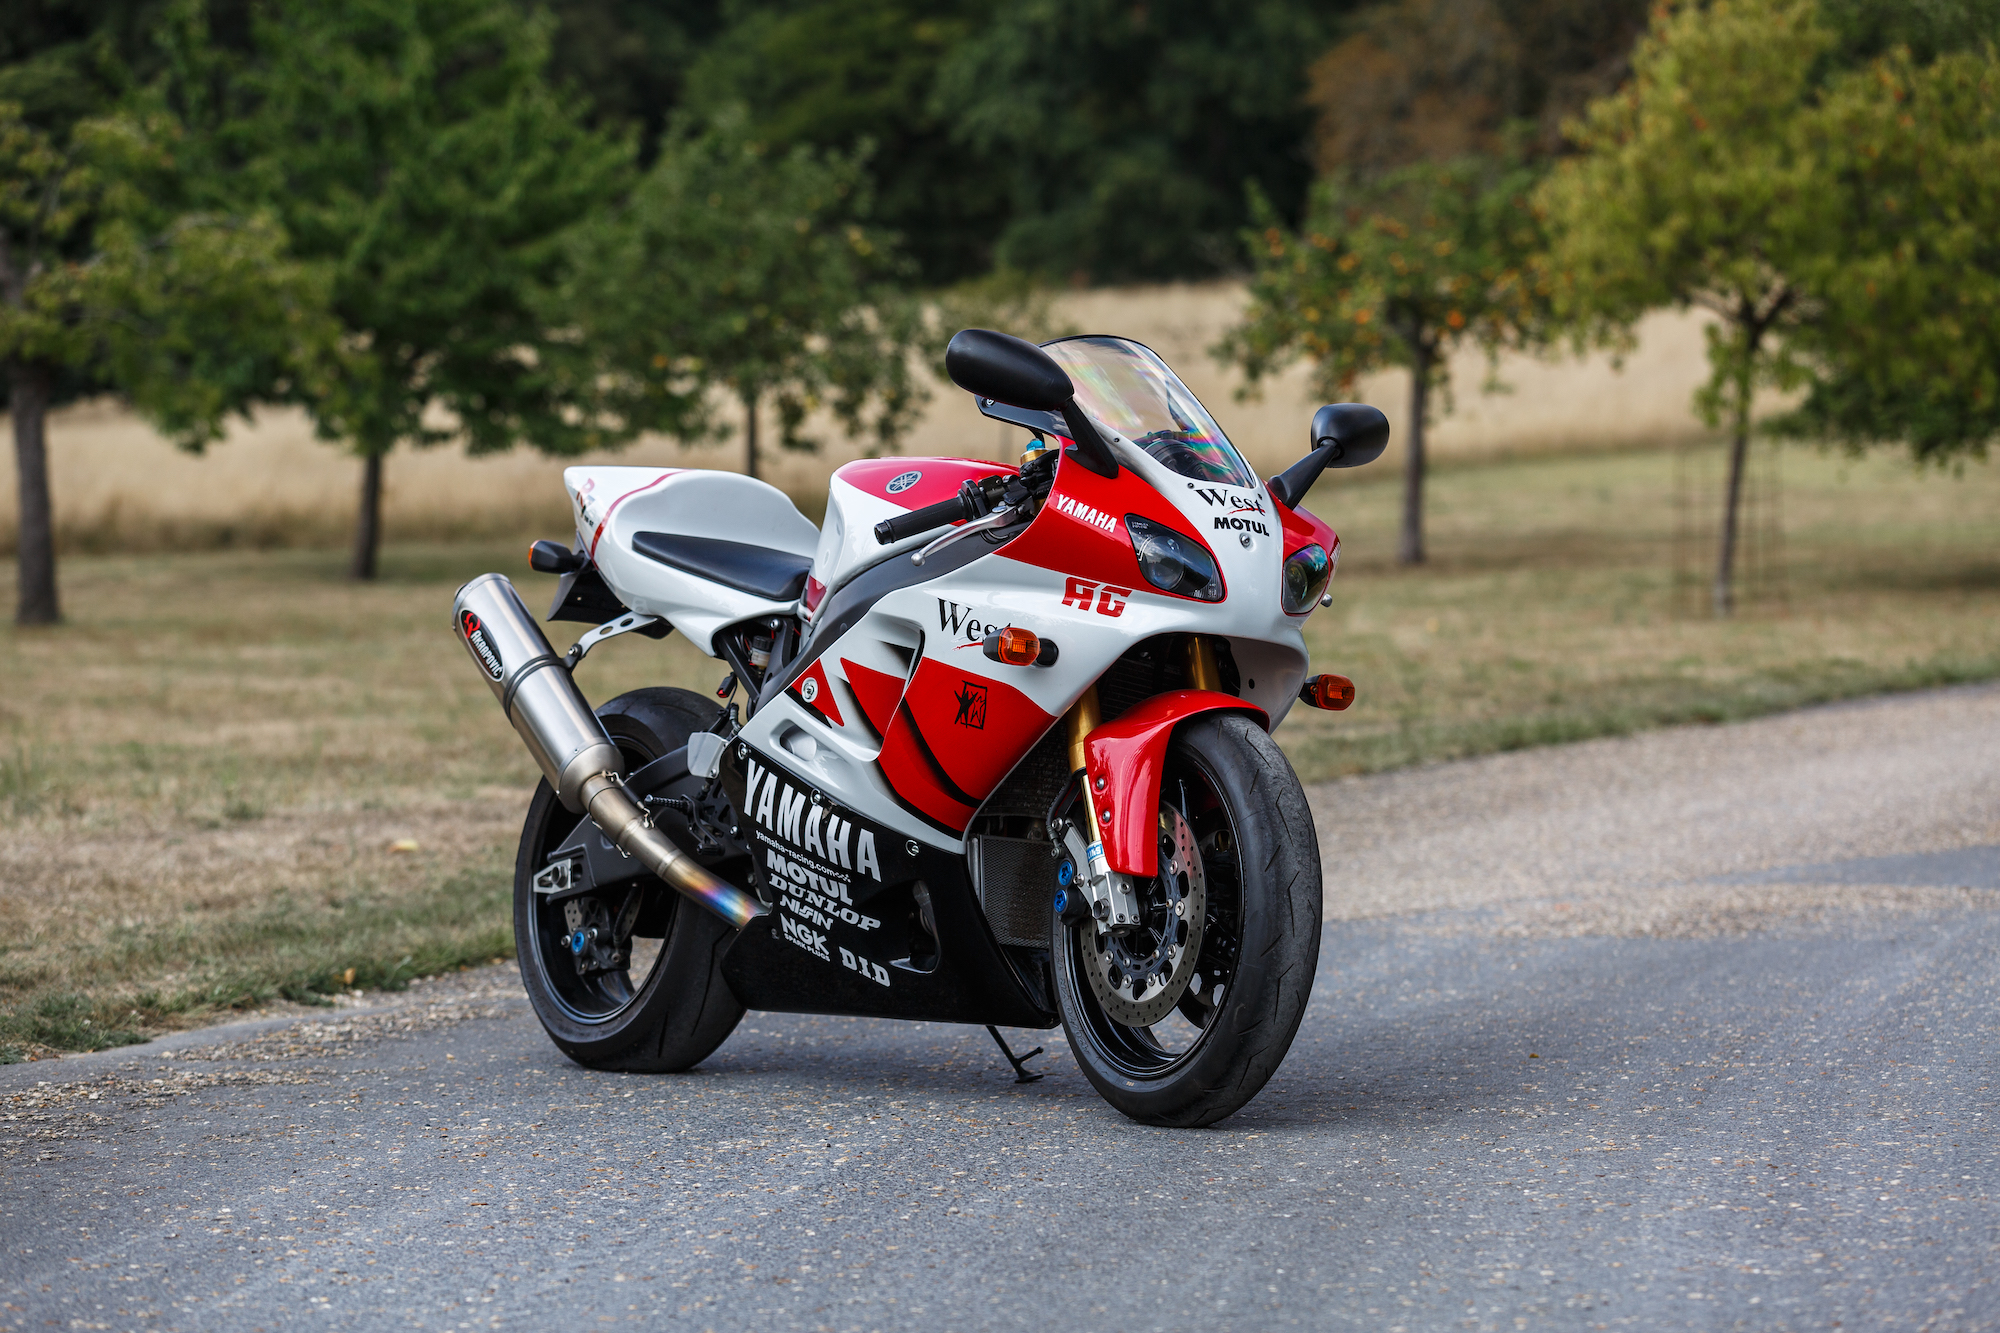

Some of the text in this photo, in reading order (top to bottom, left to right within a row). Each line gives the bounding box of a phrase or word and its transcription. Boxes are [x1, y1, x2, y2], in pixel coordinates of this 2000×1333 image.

[1057, 494, 1117, 533] YAMAHA
[1194, 489, 1265, 516] West
[1214, 517, 1269, 537] MOTUL
[938, 597, 1011, 644] Wes
[744, 758, 881, 882] YAMAHA
[756, 830, 835, 877] yamaha-racing.com
[767, 848, 853, 906] MOTUL
[769, 873, 881, 931] DUNLOP
[780, 912, 829, 955] NGK
[839, 946, 890, 987] D.I.D
